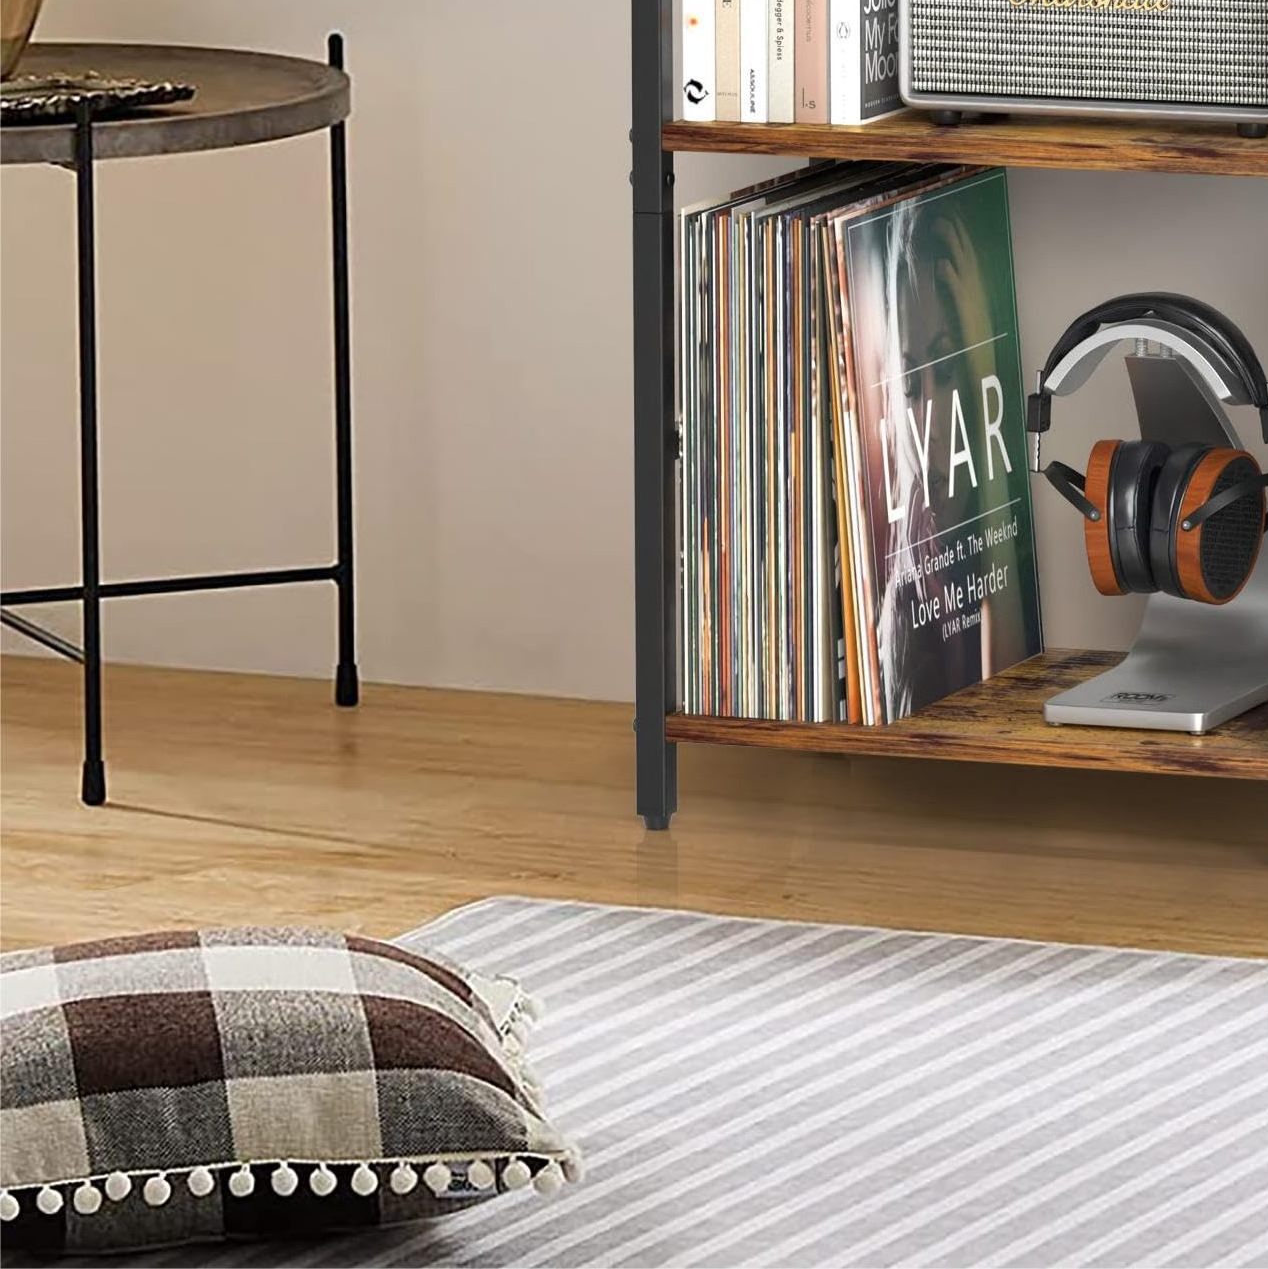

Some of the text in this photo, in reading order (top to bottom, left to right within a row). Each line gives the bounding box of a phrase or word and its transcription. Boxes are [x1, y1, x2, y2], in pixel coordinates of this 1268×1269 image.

[865, 17, 886, 55] My
[880, 374, 1013, 524] LYAR
[924, 545, 955, 575] Grande
[956, 540, 967, 561] ft.
[967, 533, 984, 555] The
[984, 516, 1018, 548] Weeknd
[911, 562, 1009, 629] Love Me Harder
